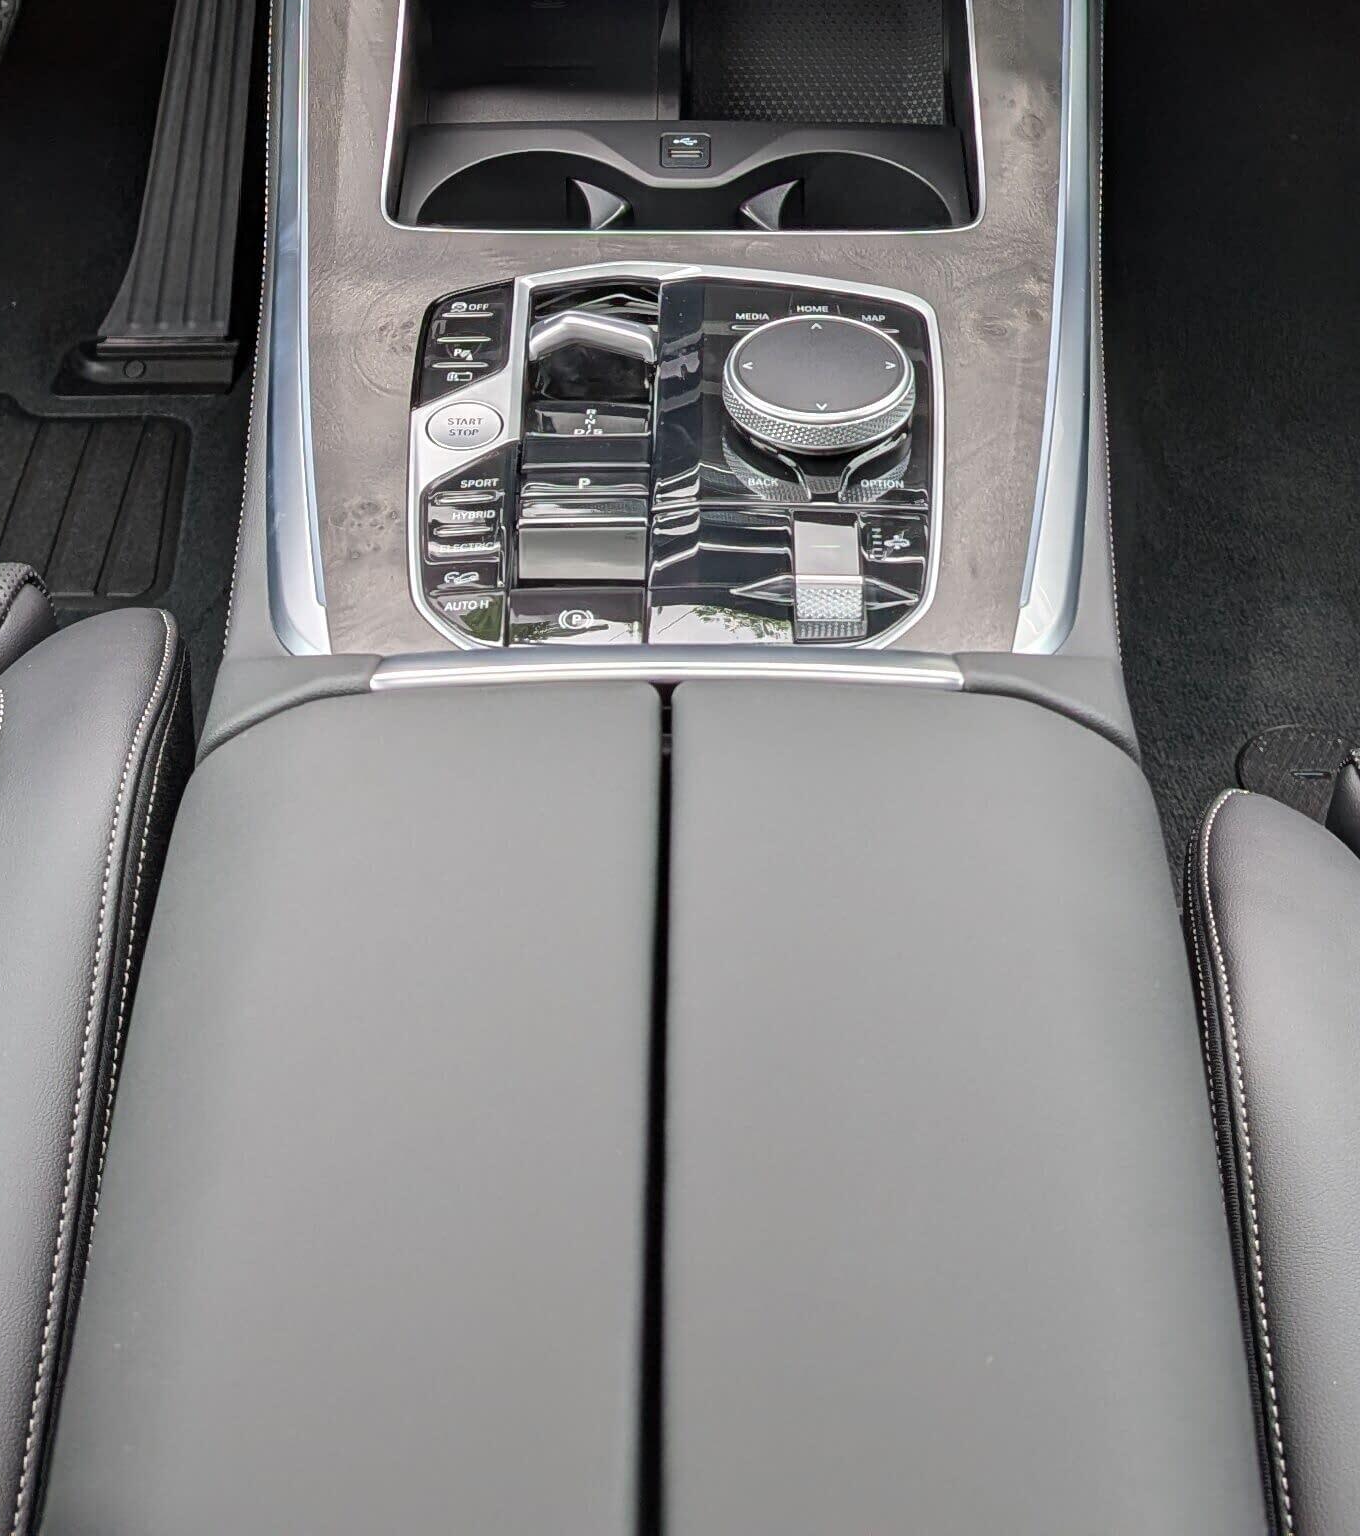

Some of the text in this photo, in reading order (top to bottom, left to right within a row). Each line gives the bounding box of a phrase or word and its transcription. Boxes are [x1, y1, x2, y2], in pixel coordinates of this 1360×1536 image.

[468, 303, 489, 311] OFF
[796, 305, 829, 313] HOME
[735, 312, 770, 321] MEDIA
[861, 314, 886, 322] MAP
[447, 417, 483, 426] START
[448, 428, 479, 436] STOP
[460, 478, 499, 488] SPORT
[578, 477, 591, 490] P
[747, 477, 779, 487] BACK
[860, 479, 904, 489] OPTION
[452, 509, 496, 520] HYBRID
[443, 599, 490, 612] AUTO H
